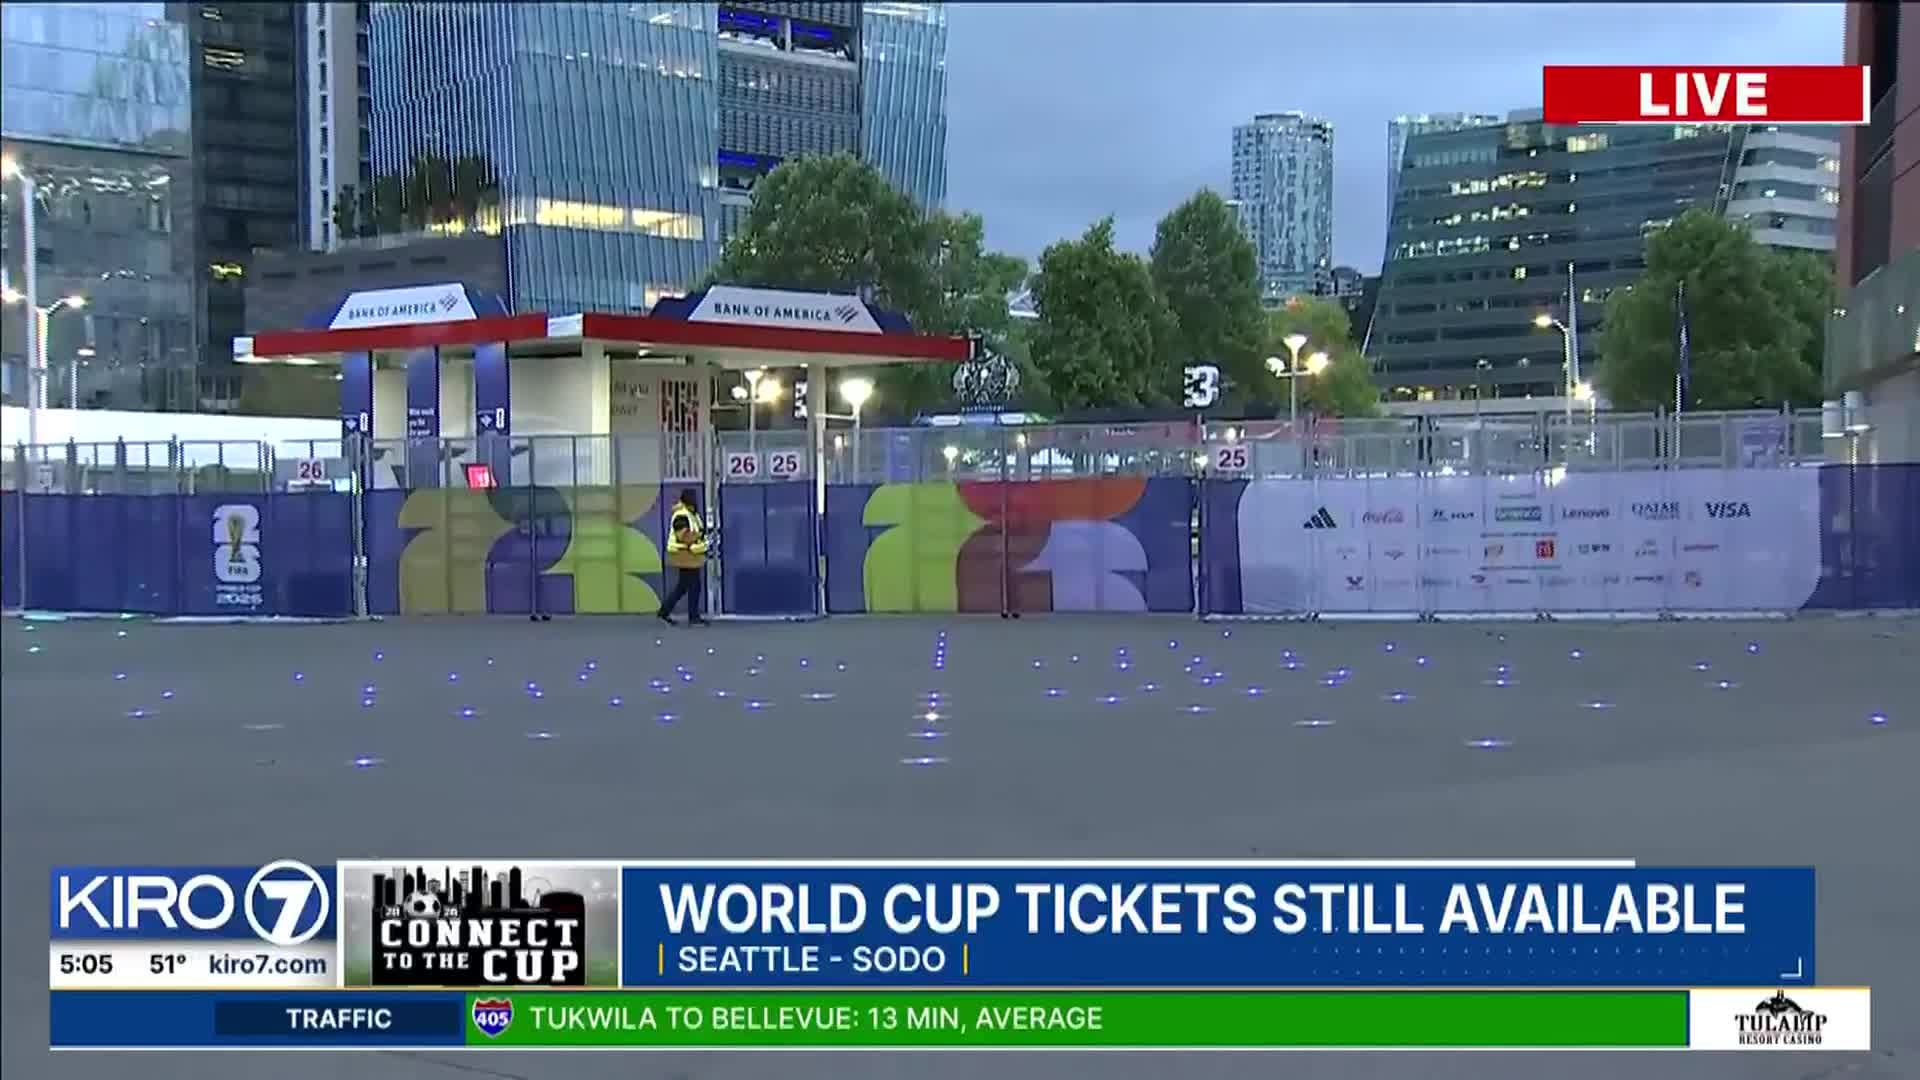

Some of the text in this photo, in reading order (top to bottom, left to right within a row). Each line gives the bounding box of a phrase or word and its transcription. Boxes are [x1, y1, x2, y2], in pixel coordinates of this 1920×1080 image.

[348, 302, 436, 320] BANK OF AMERICA
[714, 303, 831, 321] BANK OF AMERICA
[730, 457, 755, 474] 26
[772, 455, 798, 473] 25
[1219, 450, 1246, 469] 25
[300, 461, 323, 479] 26
[1562, 507, 1610, 519] Lenovo
[1705, 501, 1752, 519] VISA
